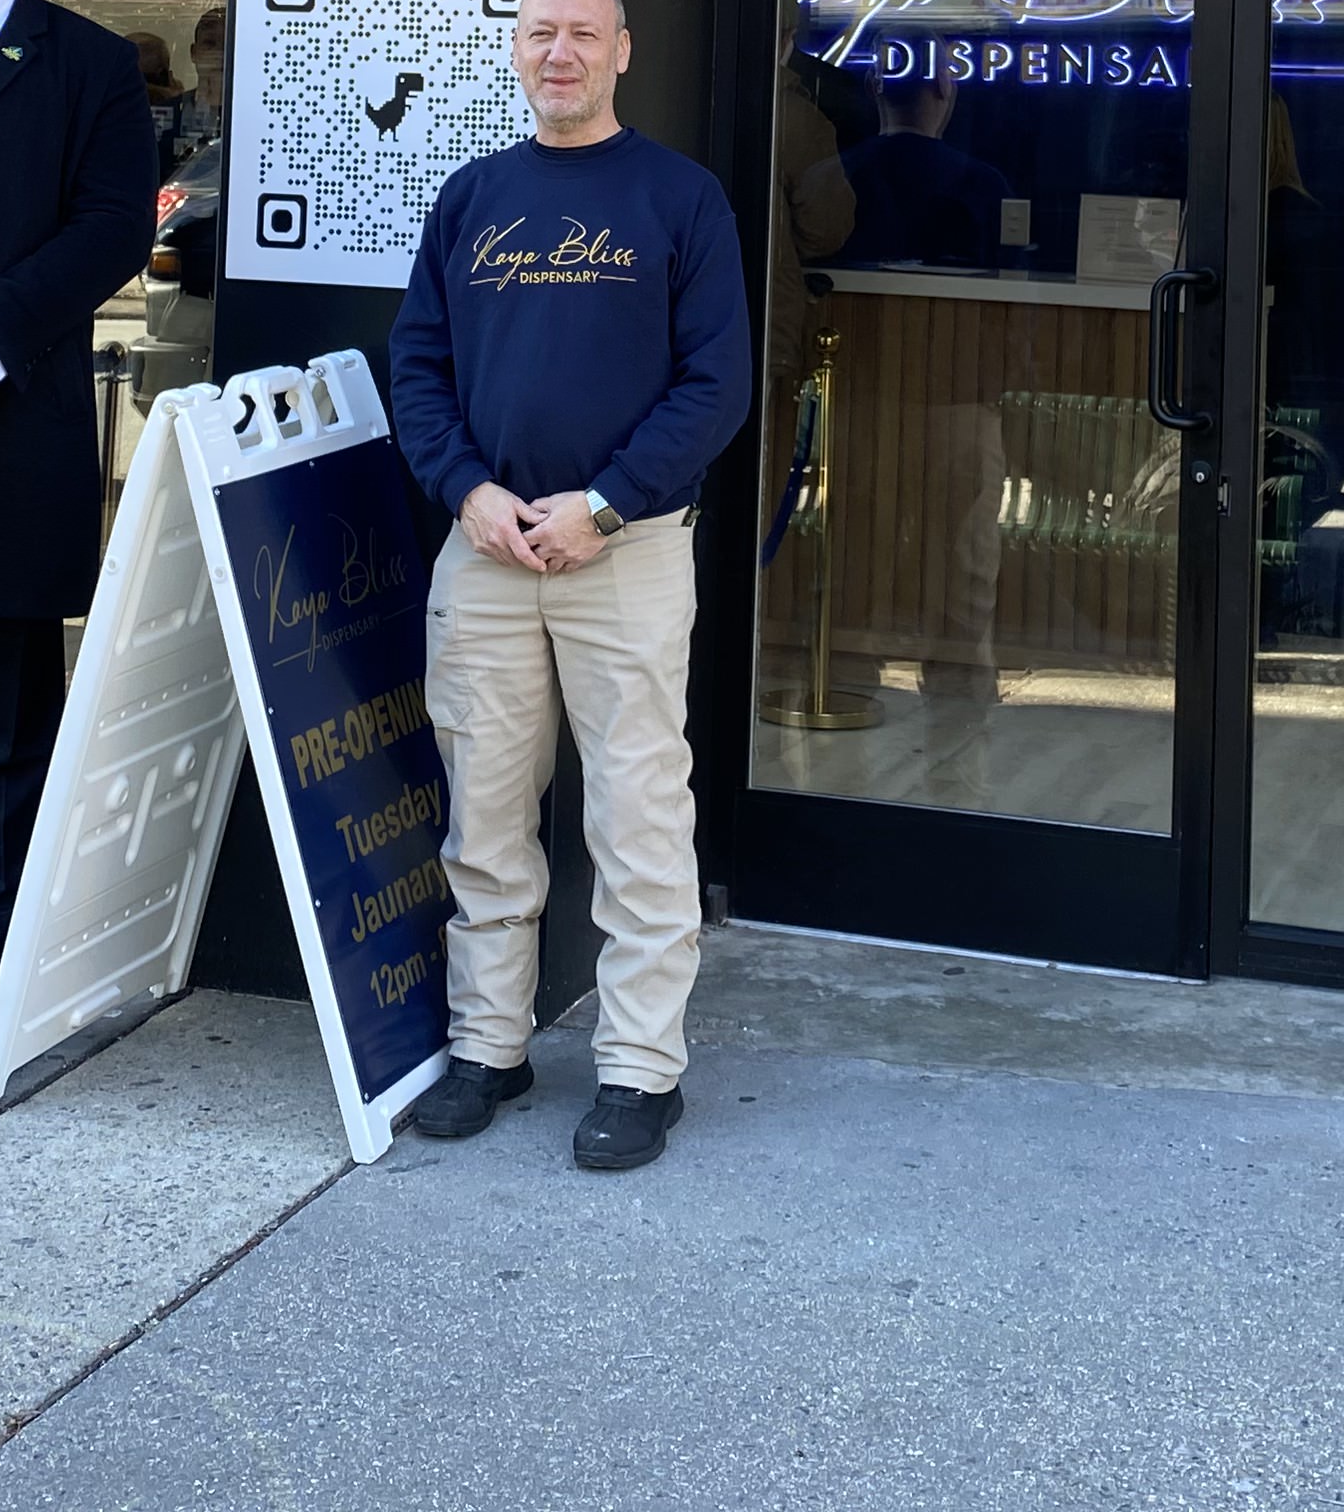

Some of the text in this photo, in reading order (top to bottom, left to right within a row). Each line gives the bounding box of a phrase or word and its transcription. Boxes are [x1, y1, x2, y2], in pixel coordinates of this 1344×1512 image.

[880, 41, 1193, 88] DISPENSA
[470, 216, 638, 291] Kaya Bliss
[519, 270, 600, 284] DISPENSARY
[254, 513, 408, 672] Kaya Bliss
[322, 615, 380, 651] DISPENSARY
[290, 677, 430, 788] PRE-OPENIN
[336, 778, 442, 863] Tuesday
[351, 856, 448, 943] Jaunary
[370, 950, 427, 1008] 12pm
